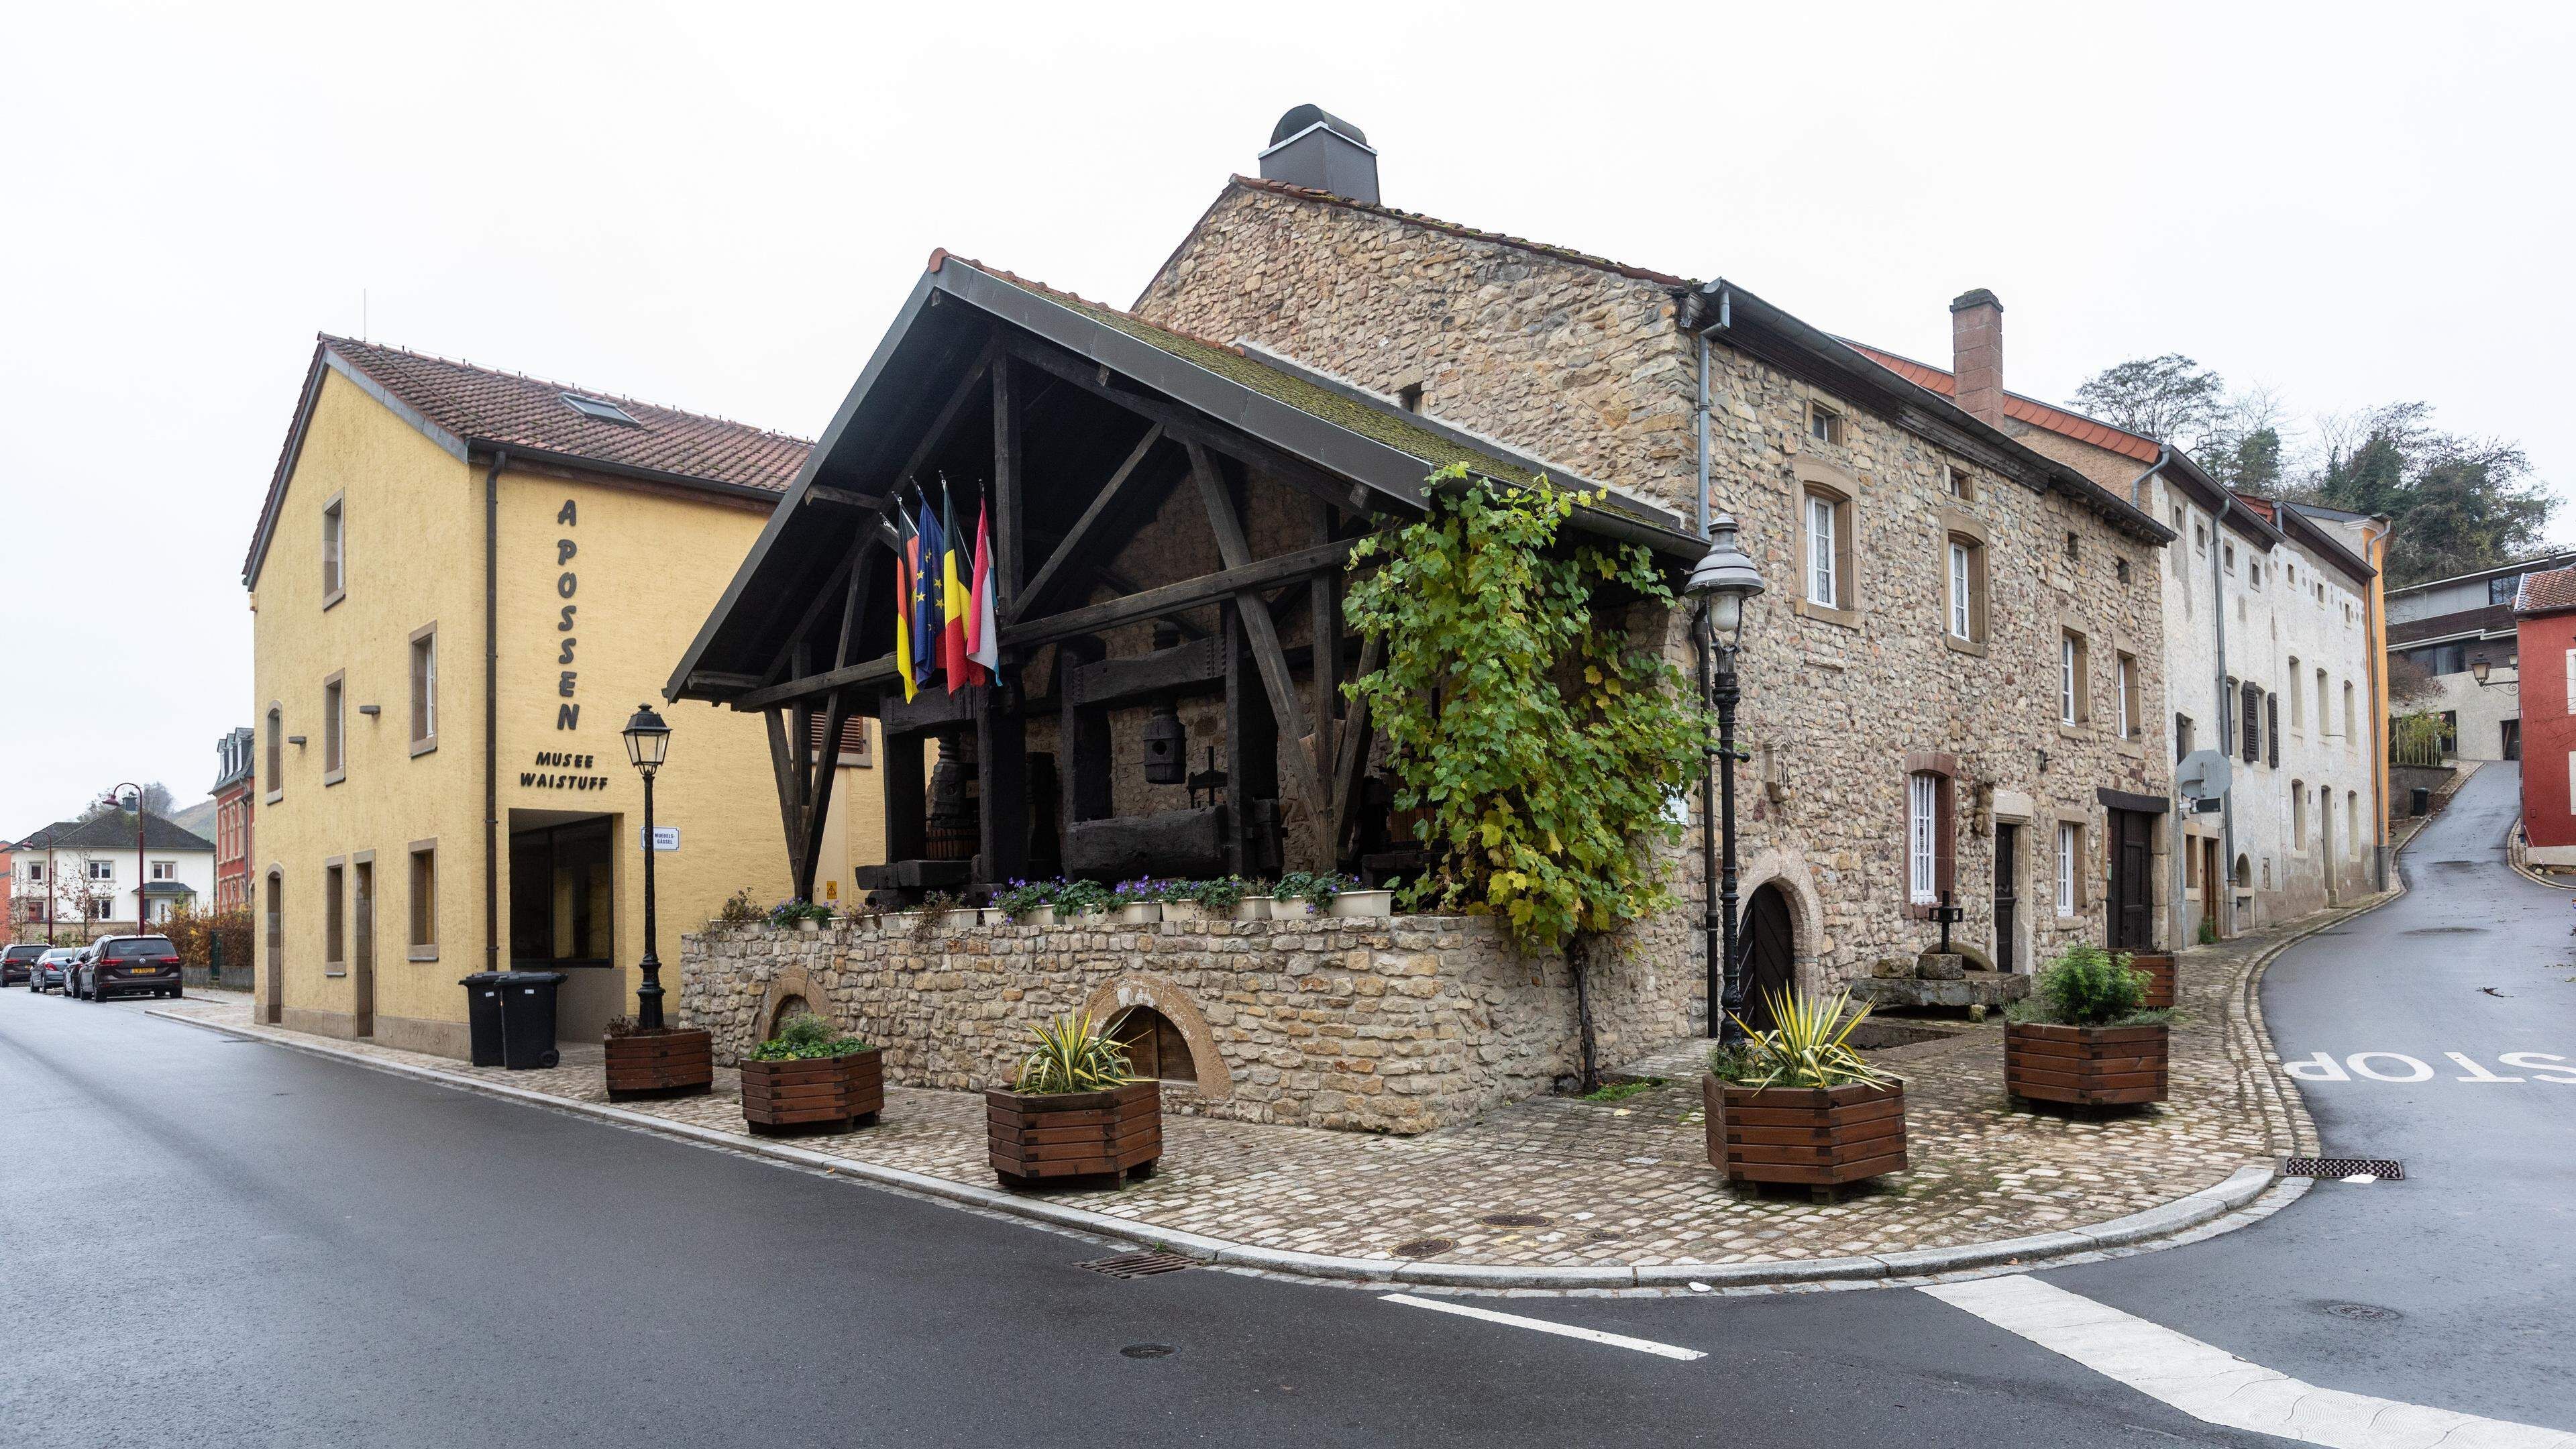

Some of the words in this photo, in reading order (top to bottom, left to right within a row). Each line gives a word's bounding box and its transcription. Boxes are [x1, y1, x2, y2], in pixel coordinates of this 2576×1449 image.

[557, 499, 580, 730] APOSSEN
[535, 751, 594, 768] MUSEE
[521, 772, 608, 790] WAISTUFF
[2282, 1051, 2576, 1084] STOP
